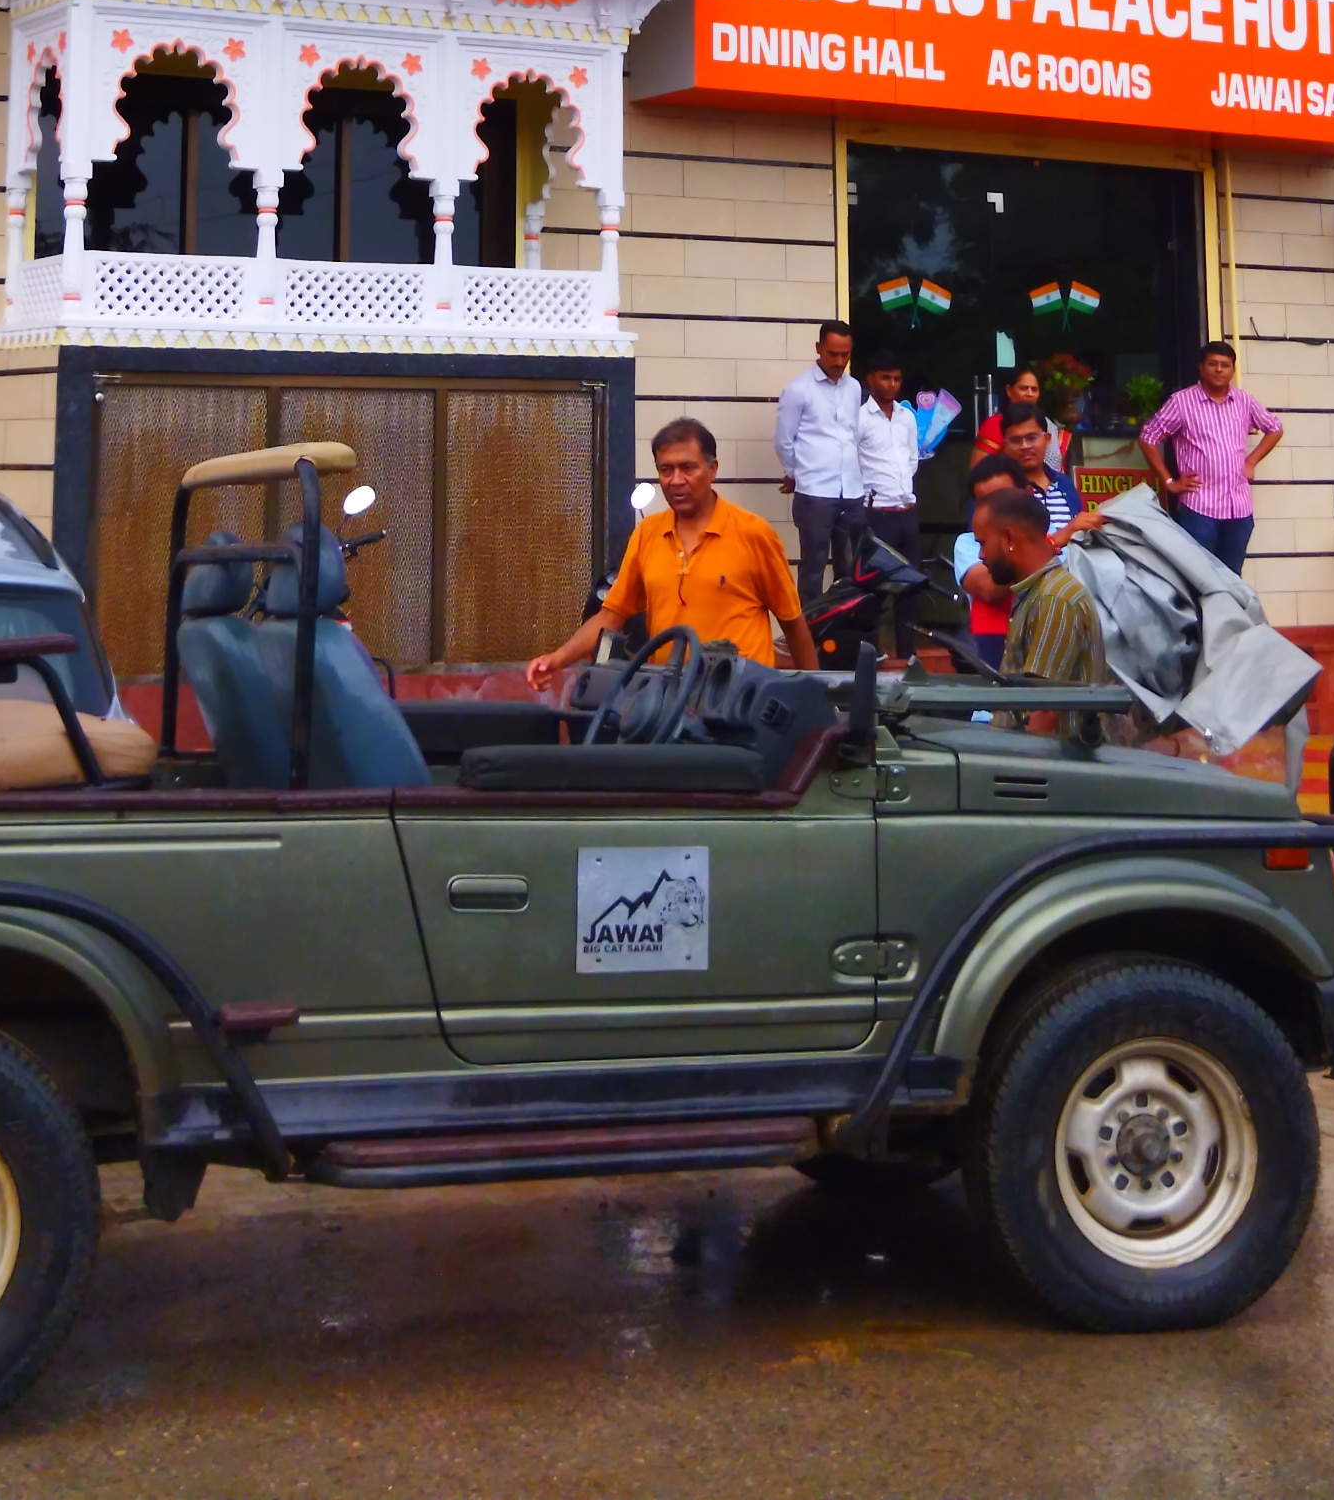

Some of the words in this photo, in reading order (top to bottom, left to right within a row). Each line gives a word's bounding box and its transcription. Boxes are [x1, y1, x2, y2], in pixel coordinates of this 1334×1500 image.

[712, 22, 846, 72] DINING
[853, 35, 946, 81] HALL
[987, 49, 1031, 89] AC
[1037, 54, 1152, 100] ROOMS
[1210, 72, 1302, 114] JAWAI
[1080, 475, 1160, 495] HINGLJ
[583, 944, 601, 954] BIG
[604, 944, 623, 953] CAT
[627, 944, 663, 953] SAFARI
